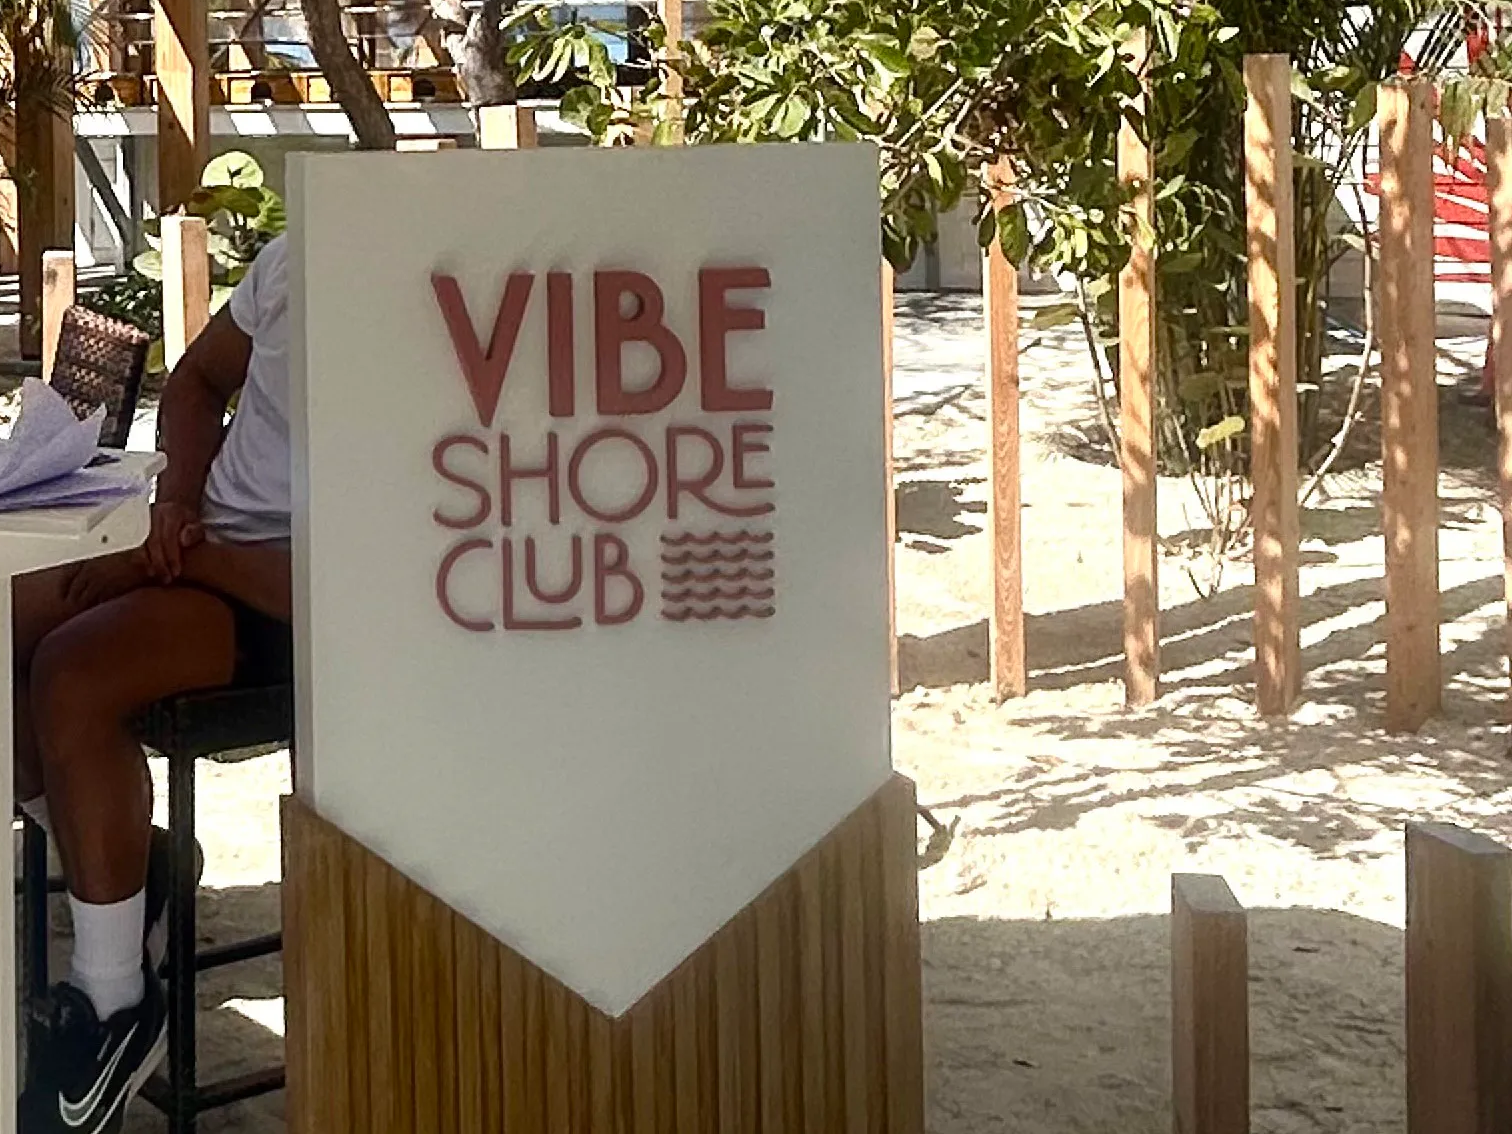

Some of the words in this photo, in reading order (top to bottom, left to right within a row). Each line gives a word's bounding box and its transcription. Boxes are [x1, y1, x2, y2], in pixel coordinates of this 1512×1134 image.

[430, 267, 774, 428] VIBE
[431, 423, 775, 530] SHORE
[435, 533, 645, 632] CLUB
